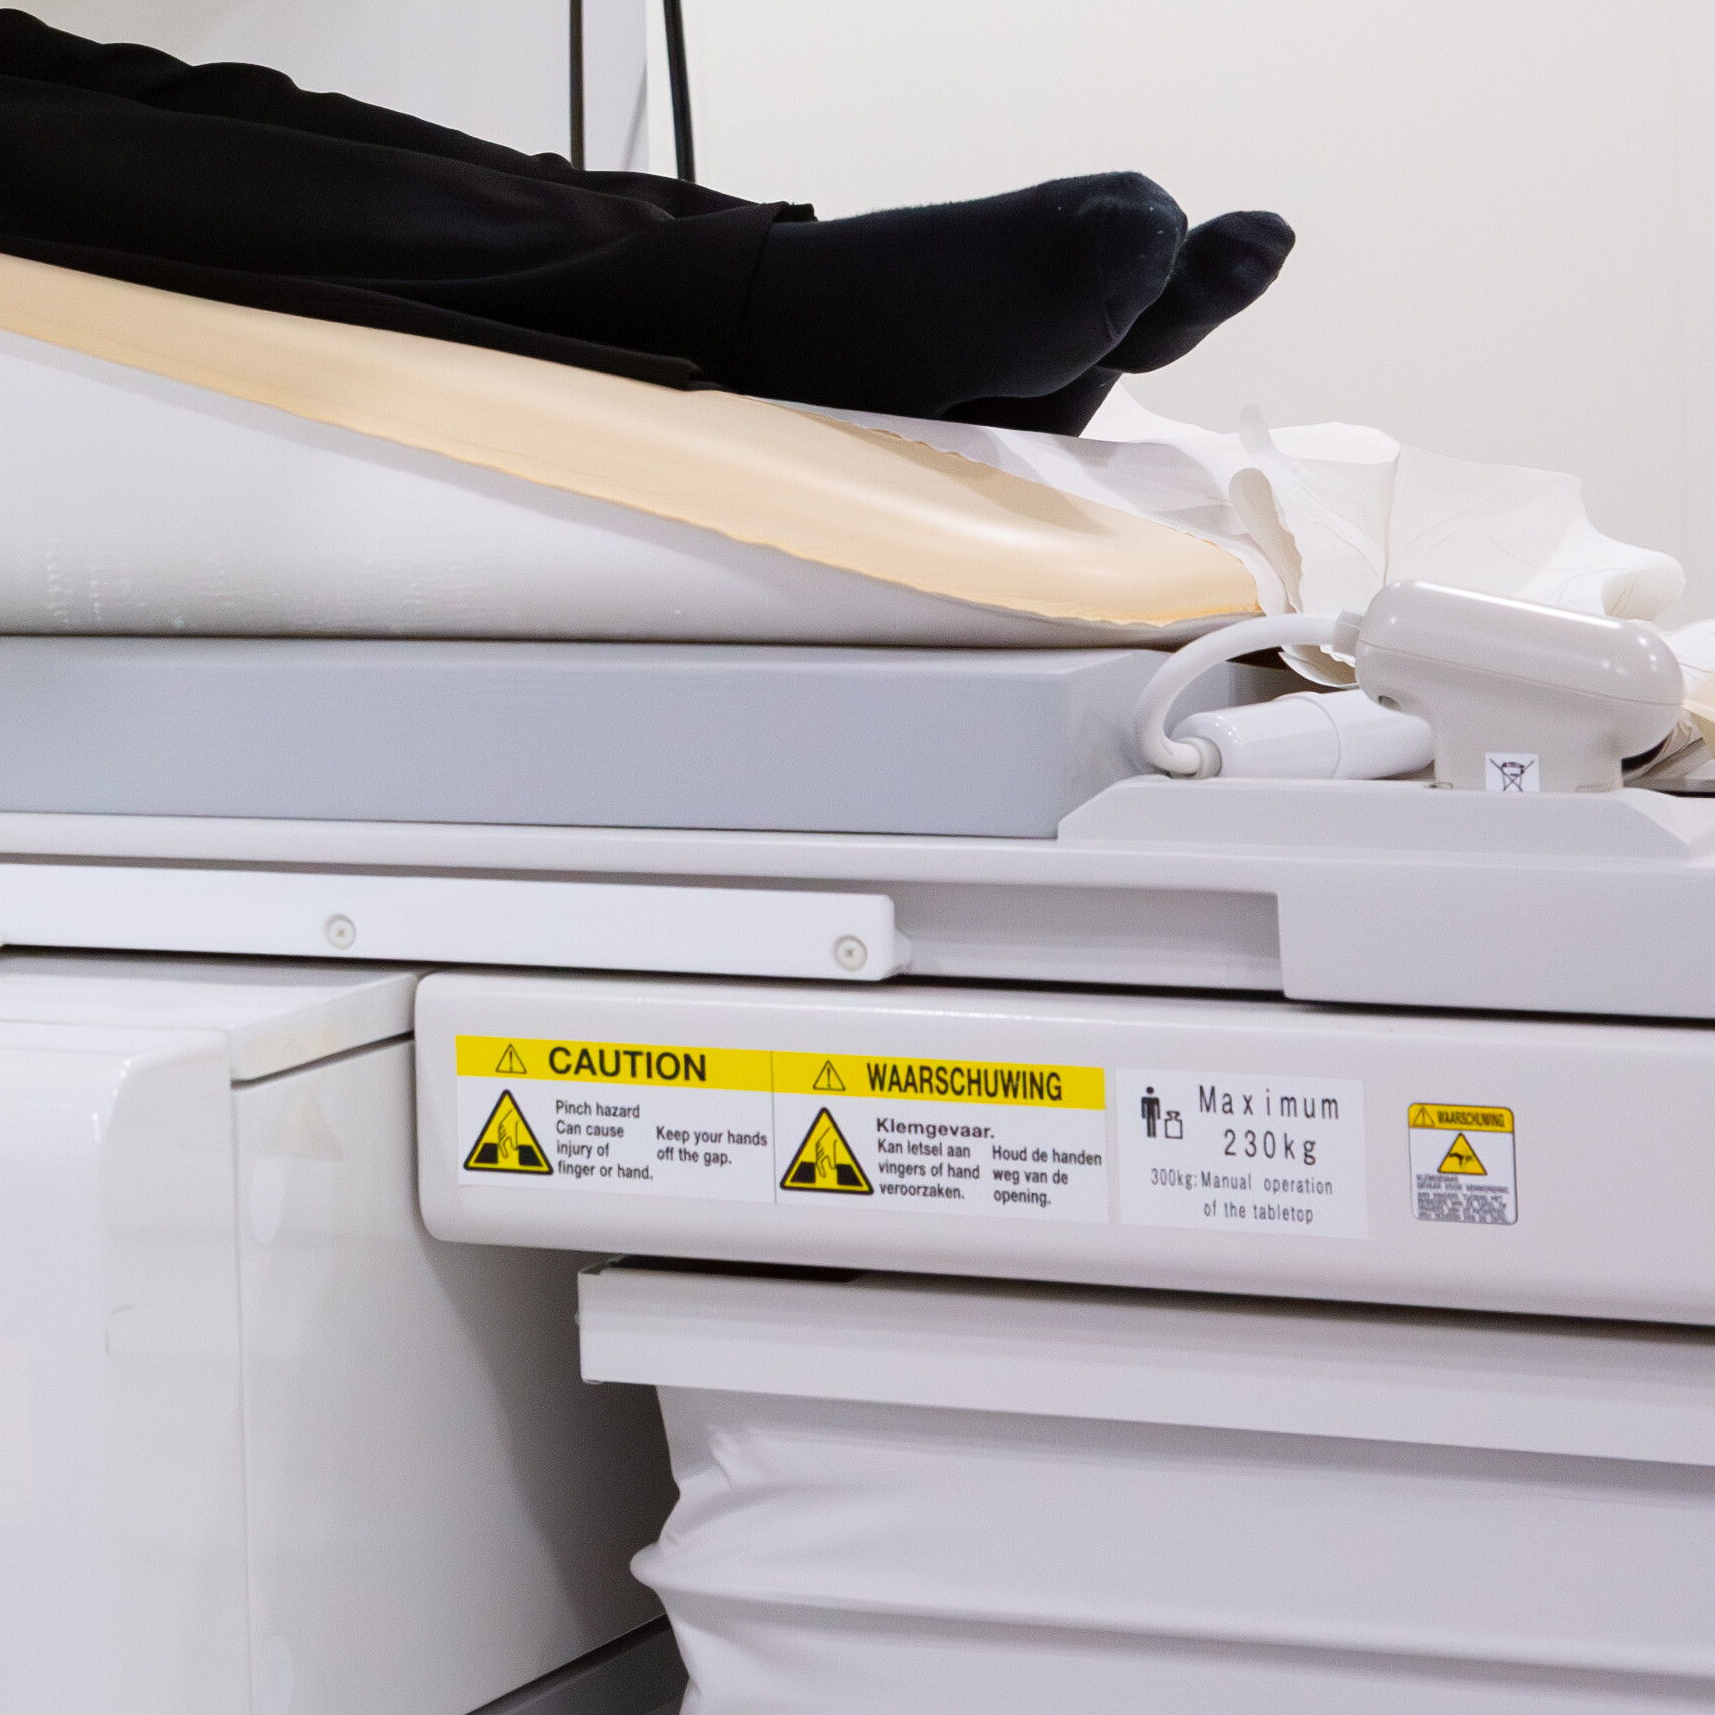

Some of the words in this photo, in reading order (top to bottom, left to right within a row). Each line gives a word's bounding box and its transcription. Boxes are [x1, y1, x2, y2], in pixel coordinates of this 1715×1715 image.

[548, 1046, 707, 1082] CAUTION
[866, 1062, 1063, 1101] WAARSCHUWING
[555, 1099, 592, 1116] Pinch
[595, 1101, 641, 1119] hazard
[1199, 1084, 1339, 1120] Maximum
[556, 1120, 582, 1135] Can
[585, 1124, 624, 1138] cause
[656, 1125, 690, 1144] Keep
[693, 1130, 722, 1146] your
[727, 1129, 768, 1146] hands
[876, 1117, 995, 1138] Klemgevaar.
[557, 1140, 593, 1158] injury
[597, 1142, 610, 1157] of
[657, 1147, 674, 1161] off
[678, 1148, 699, 1163] the
[704, 1151, 732, 1166] gap.
[877, 1138, 903, 1154] Kan
[907, 1140, 943, 1157] letsel
[947, 1145, 971, 1158] aan
[992, 1145, 1027, 1162] Houd
[1032, 1147, 1048, 1163] de
[1052, 1148, 1102, 1166] handen
[1224, 1128, 1316, 1166] 230kg
[558, 1160, 596, 1179] finger
[599, 1165, 612, 1177] or
[617, 1163, 653, 1180] hand.
[878, 1161, 926, 1177] vingers
[930, 1162, 945, 1177] of
[947, 1162, 981, 1180] hand
[993, 1169, 1020, 1185] weg
[1024, 1171, 1047, 1184] van
[1052, 1169, 1069, 1185] de
[879, 1183, 965, 1199] veroorzaken.
[1264, 1177, 1334, 1195] operation
[993, 1189, 1052, 1208] opening.
[1203, 1199, 1218, 1218] of
[1223, 1201, 1246, 1219] the
[1253, 1203, 1314, 1225] tabletop
